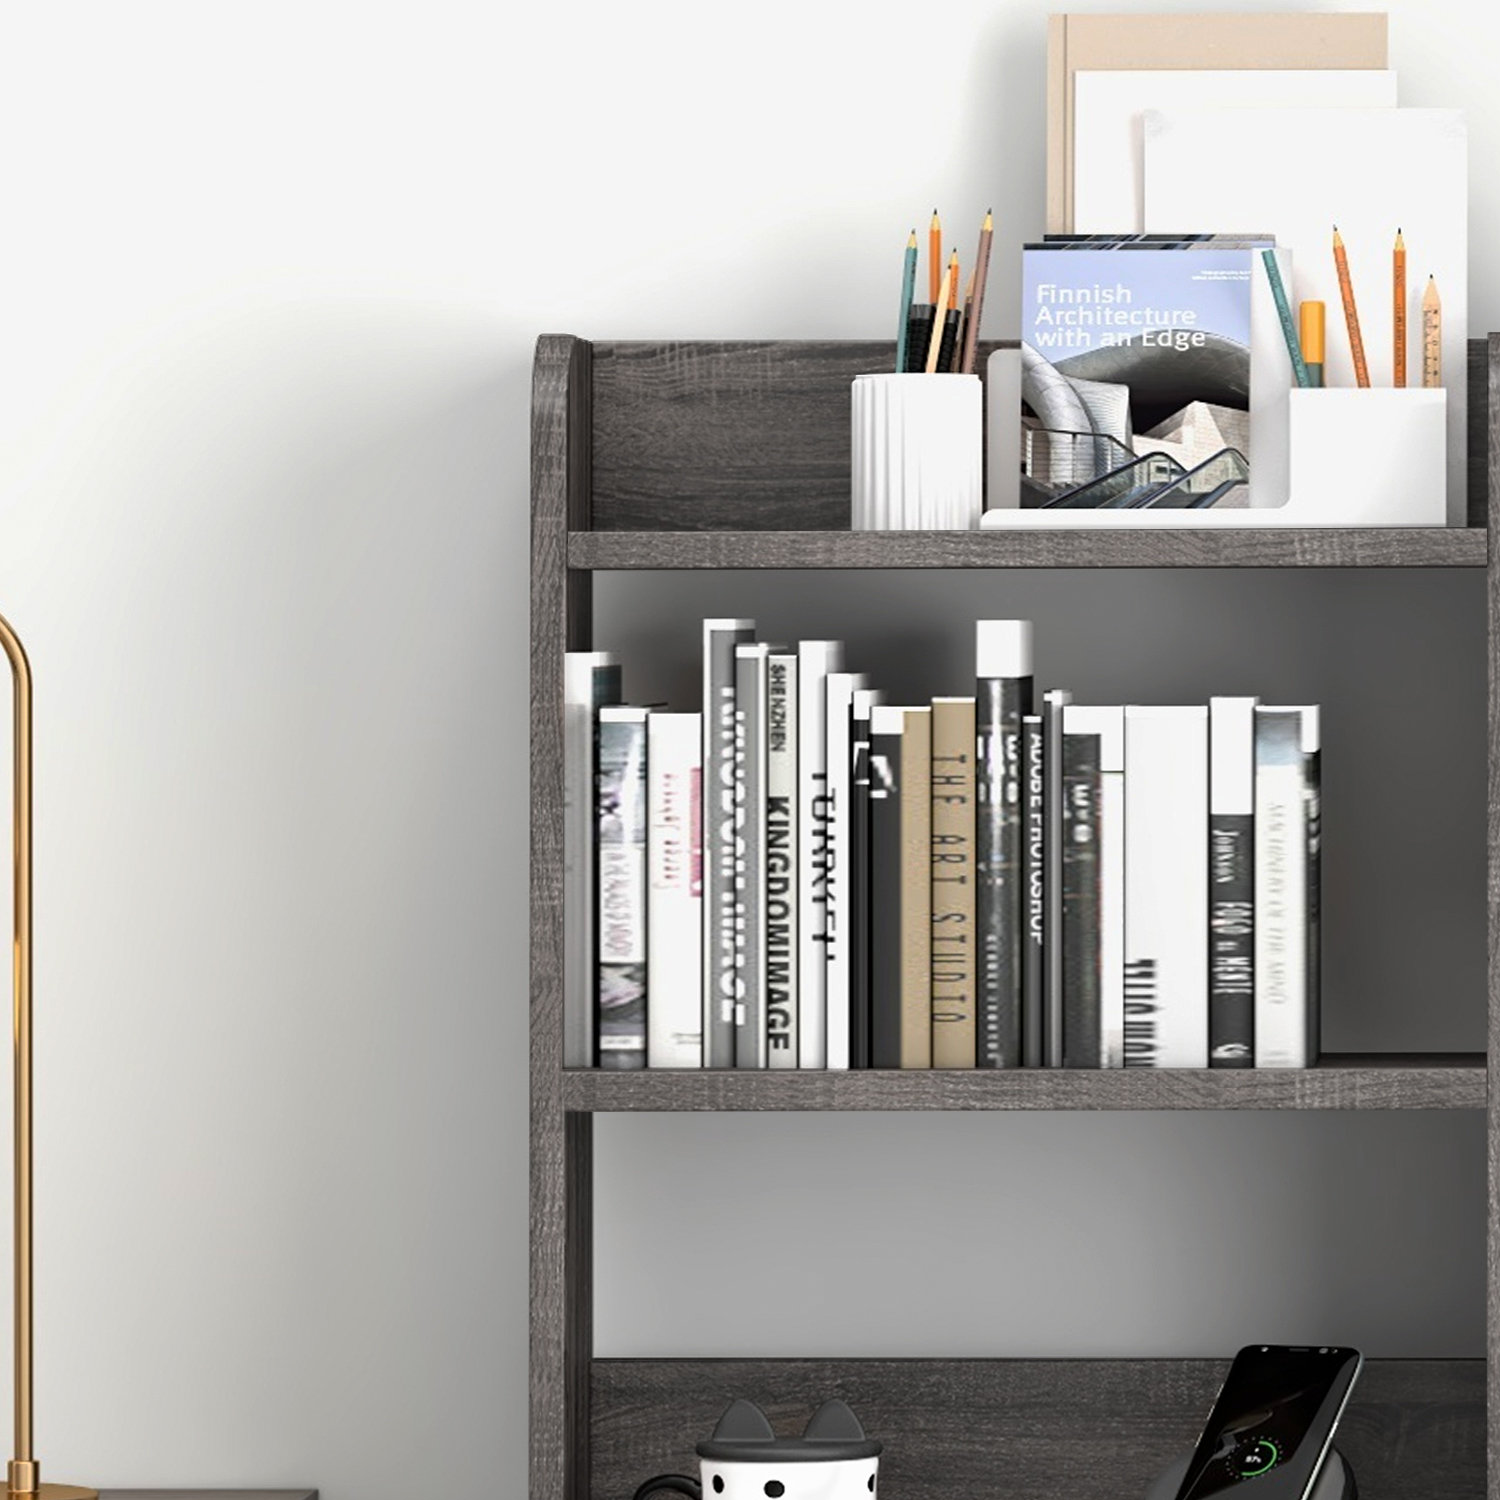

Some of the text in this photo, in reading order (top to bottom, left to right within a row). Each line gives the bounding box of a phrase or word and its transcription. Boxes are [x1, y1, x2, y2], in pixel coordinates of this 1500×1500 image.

[1037, 283, 1132, 304] Finnish
[1035, 306, 1197, 326] Architecture
[1035, 327, 1206, 351] with an Edge
[770, 664, 786, 752] SHENZHEN
[932, 754, 967, 1022] THE ART STUDIO
